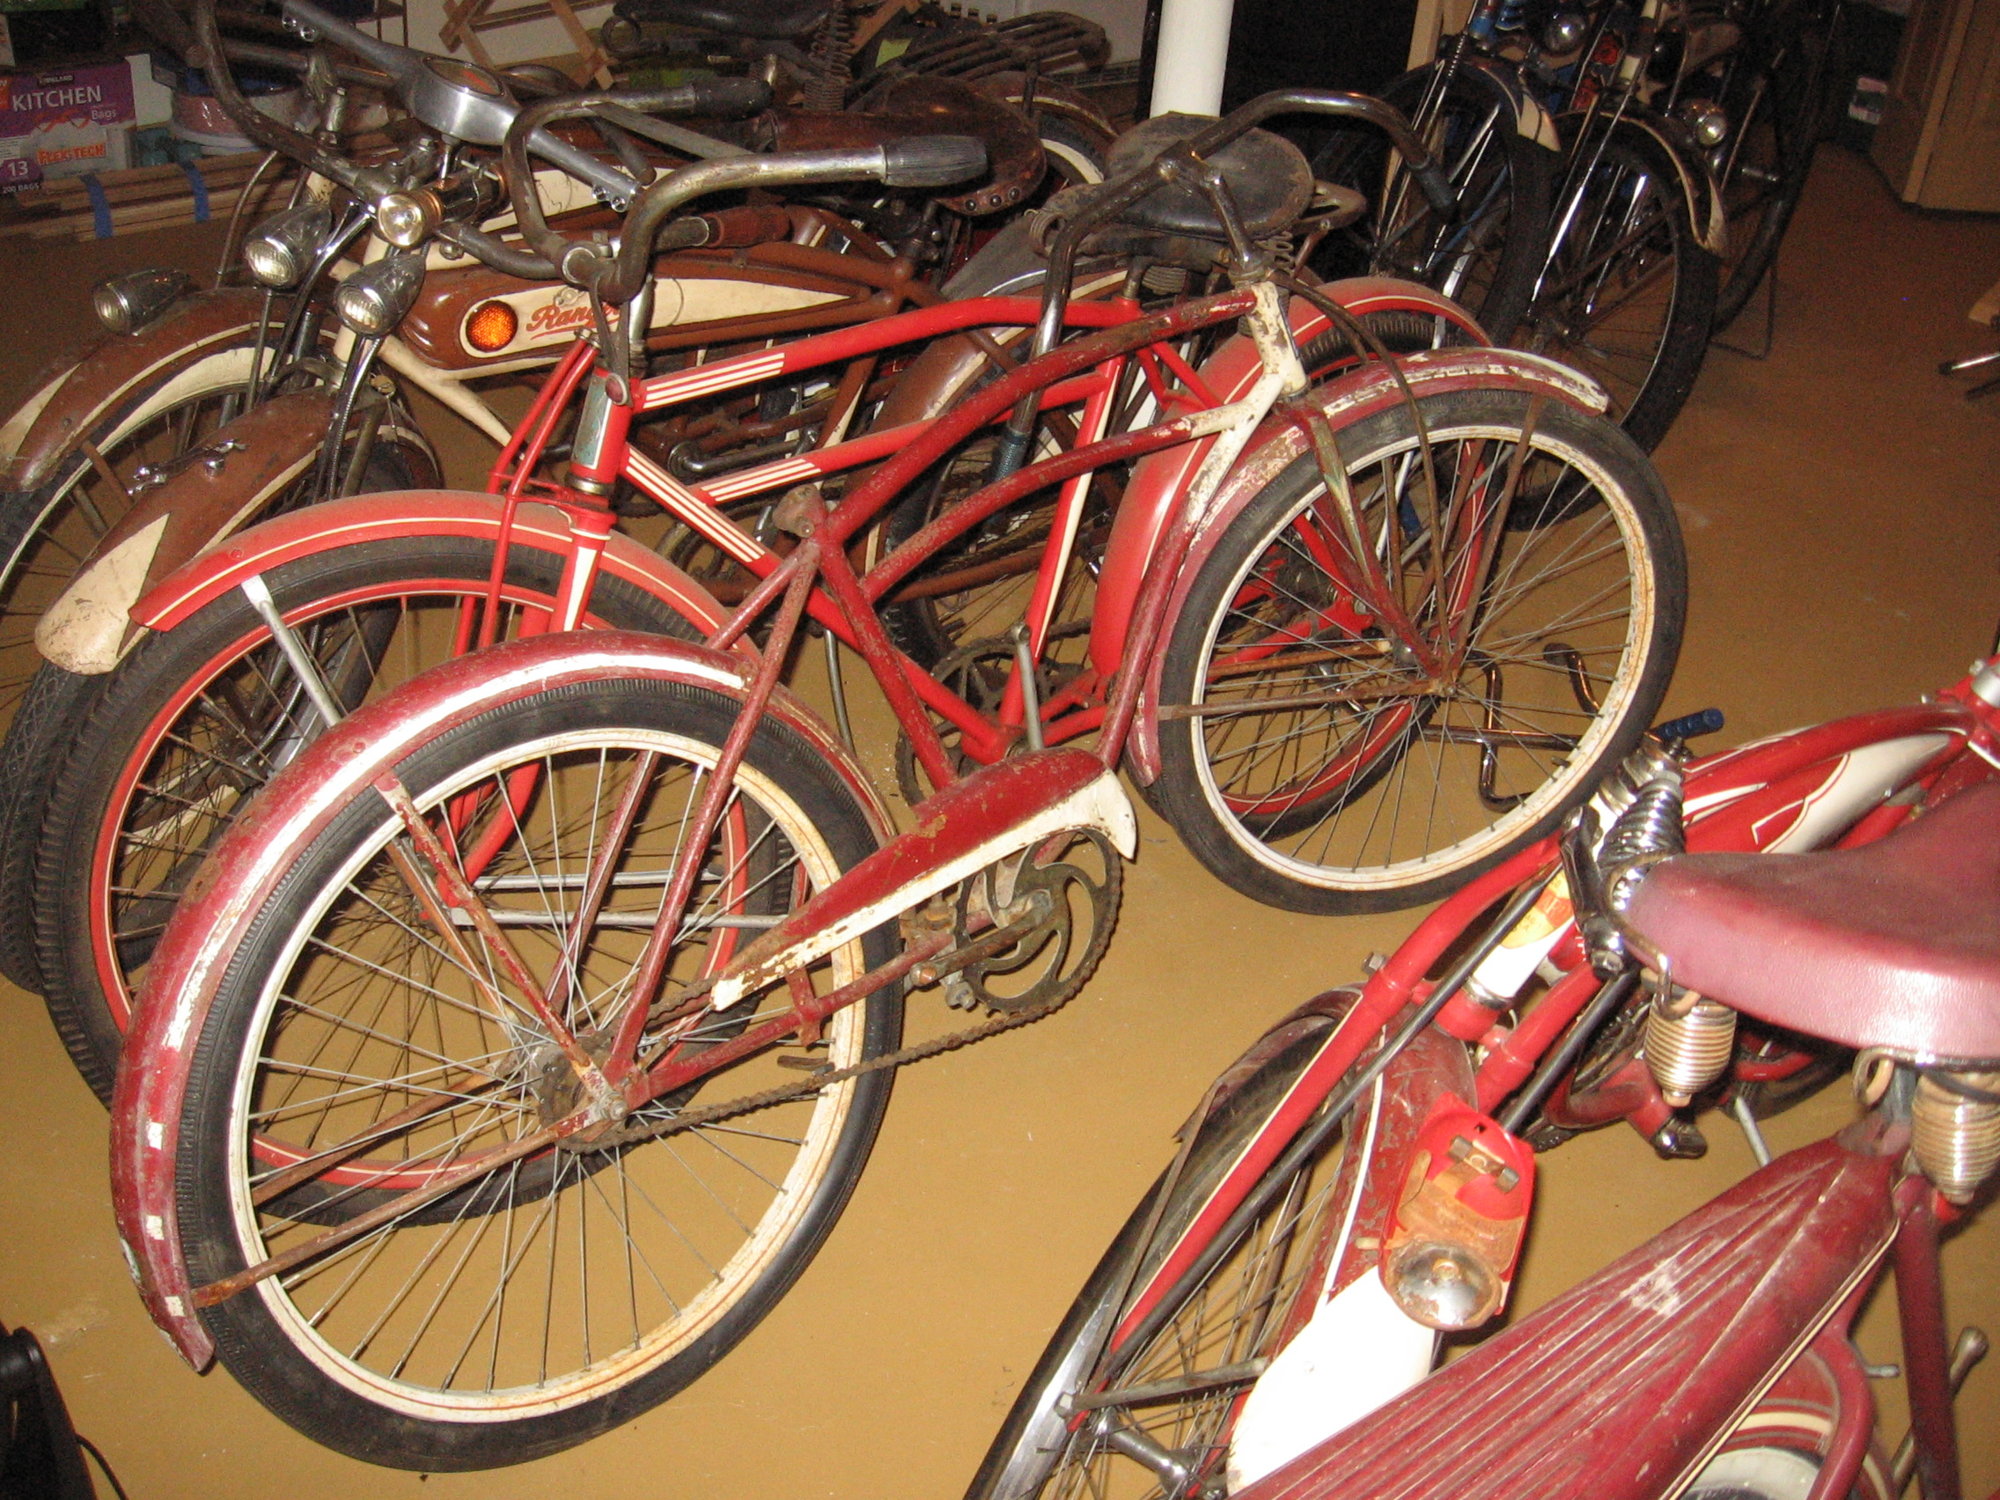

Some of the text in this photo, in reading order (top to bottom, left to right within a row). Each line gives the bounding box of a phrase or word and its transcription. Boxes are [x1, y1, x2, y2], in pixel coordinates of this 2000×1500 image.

[12, 85, 102, 112] KITCHEN
[91, 109, 117, 120] Bags
[8, 160, 29, 177] 13
[18, 182, 40, 191] BAGS
